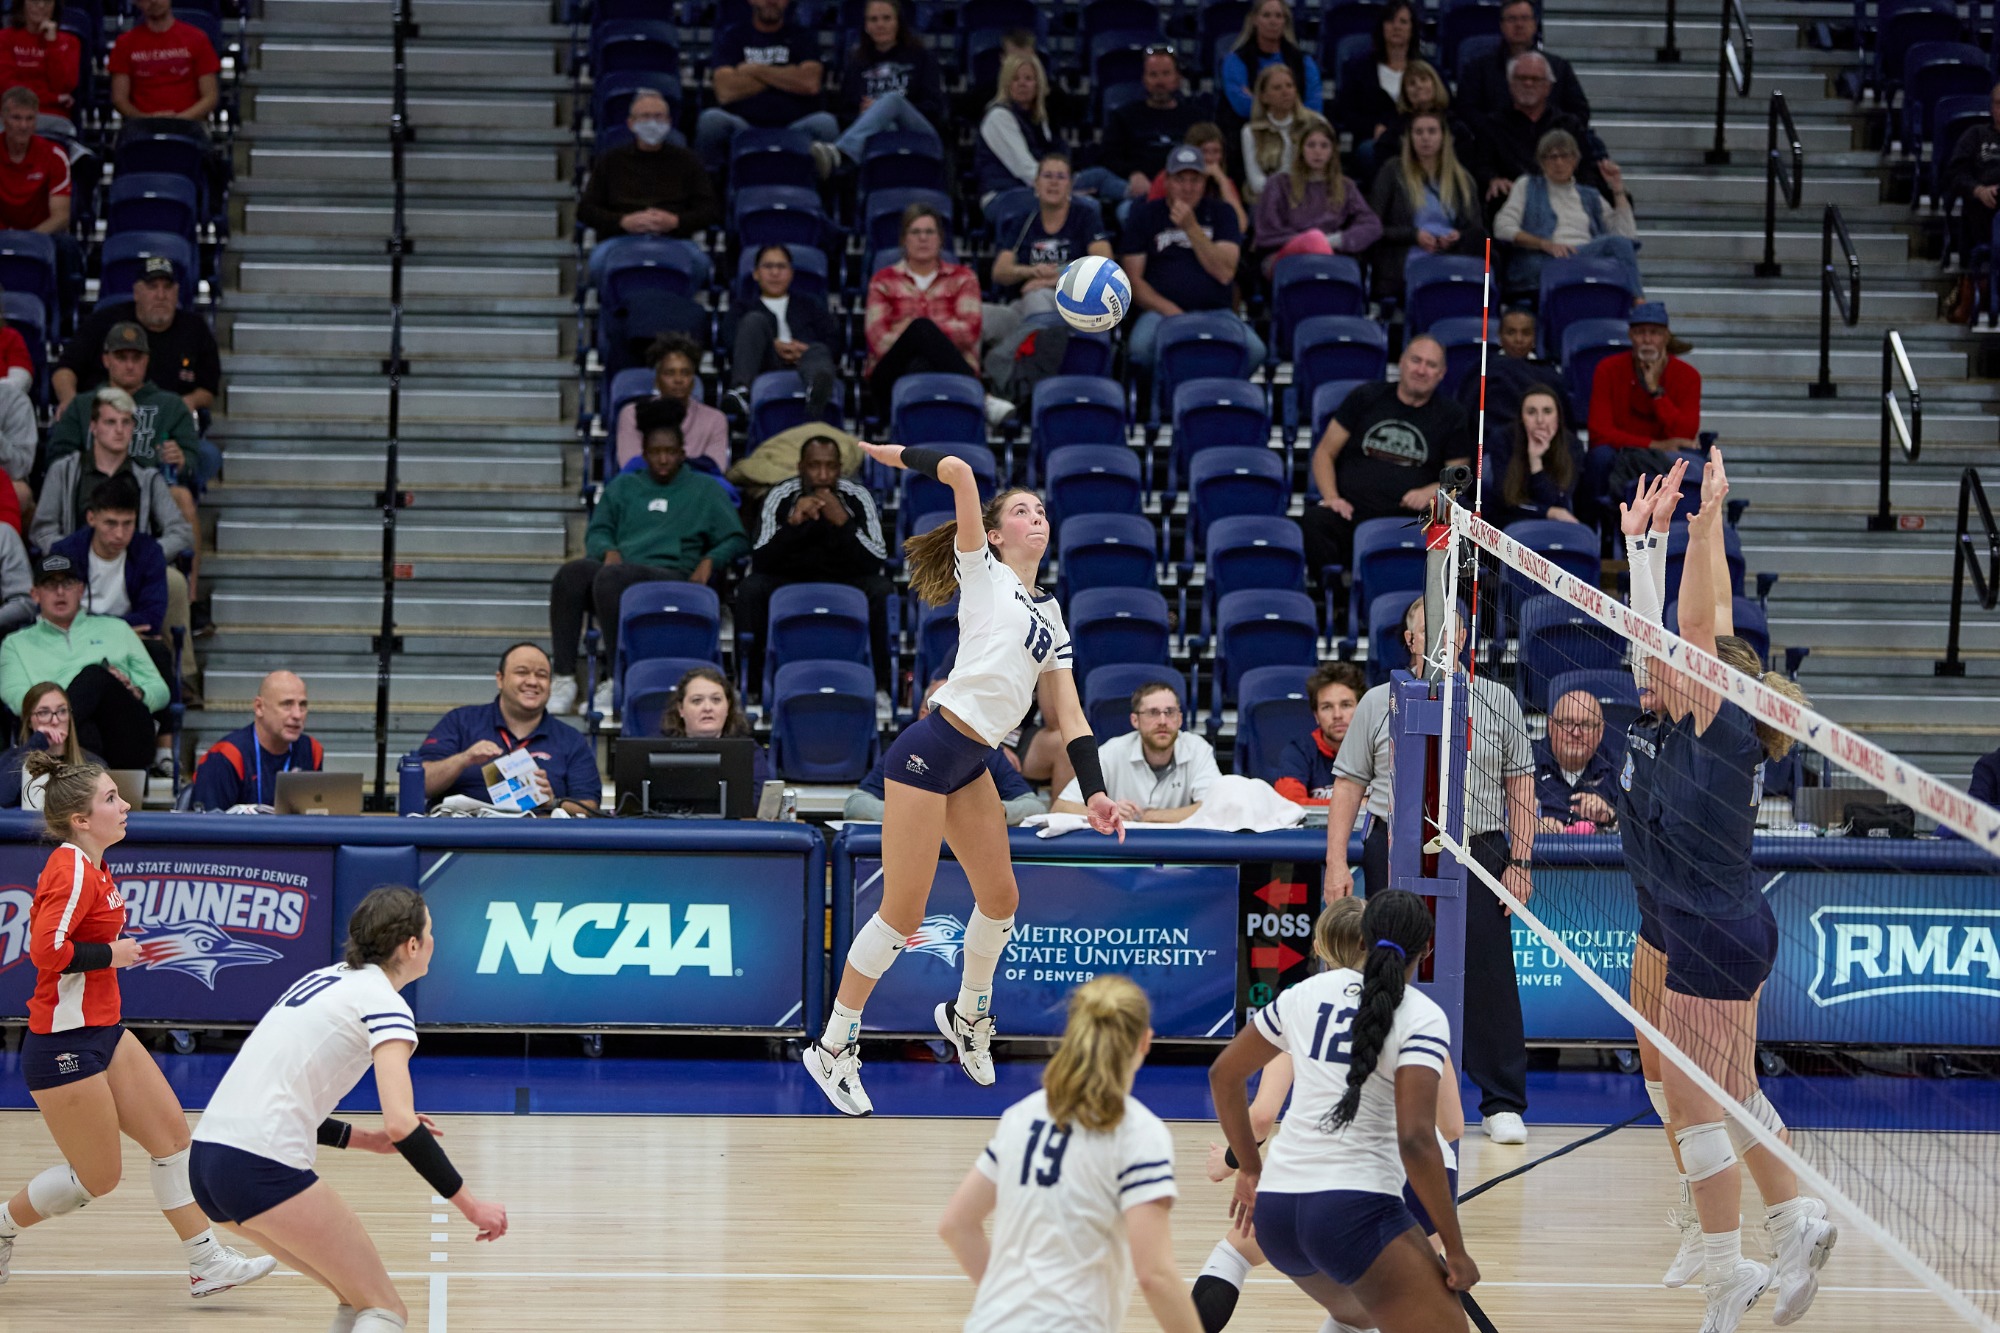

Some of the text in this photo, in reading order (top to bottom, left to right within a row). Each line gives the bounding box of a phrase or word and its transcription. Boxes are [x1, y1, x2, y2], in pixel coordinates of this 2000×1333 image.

[1024, 615, 1052, 663] 18
[136, 861, 172, 874] STATE
[174, 862, 245, 879] UNIVERSITY
[245, 866, 261, 880] OF
[262, 869, 309, 888] DENVER
[475, 901, 734, 977] NCAA
[1008, 924, 1189, 945] METROPOLITAN
[1247, 913, 1311, 938] POSS
[1005, 943, 1208, 966] STATE UNIVERSITY
[1005, 968, 1094, 983] OF DENVER
[1516, 974, 1562, 987] ENVER
[274, 973, 342, 1007] 10
[1307, 1002, 1360, 1065] 12
[1020, 1119, 1073, 1187] 19
